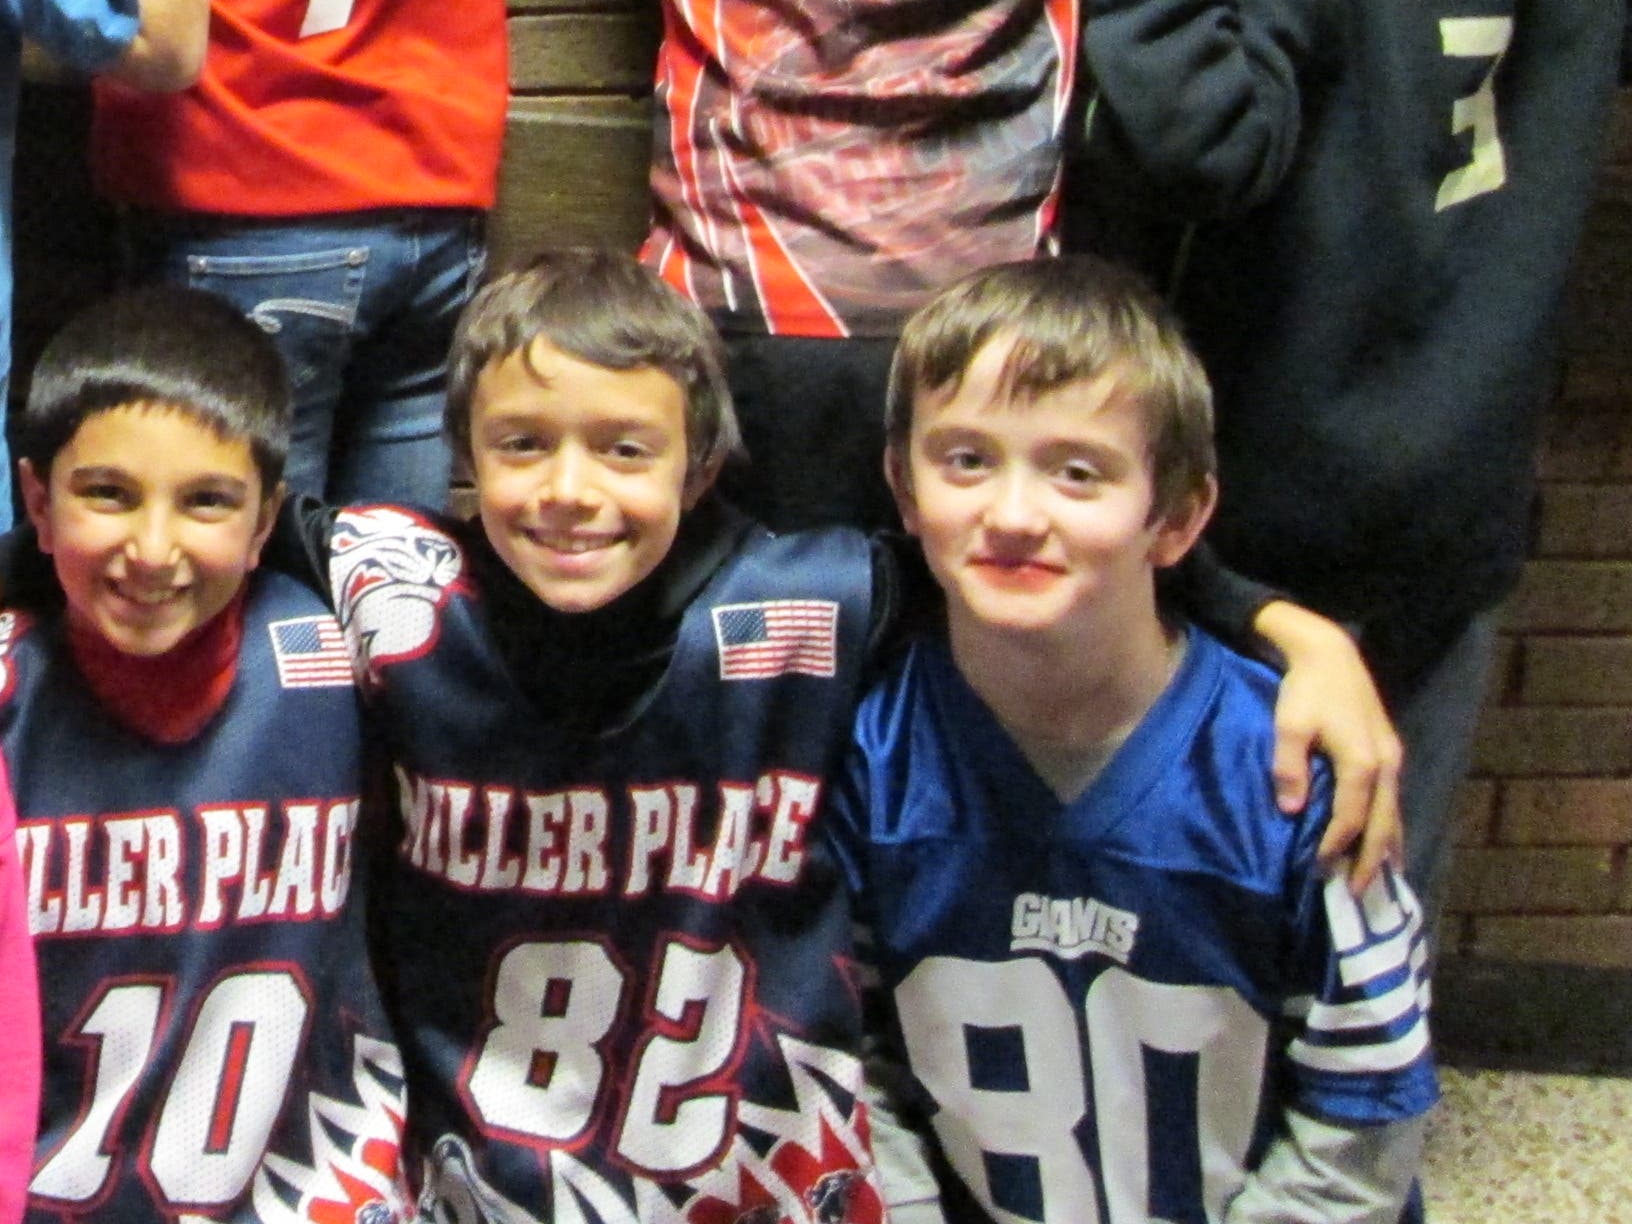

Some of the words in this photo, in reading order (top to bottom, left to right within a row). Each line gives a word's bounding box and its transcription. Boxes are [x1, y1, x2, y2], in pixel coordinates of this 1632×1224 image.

[1010, 891, 1140, 962] GIANTS
[23, 963, 313, 1214] 10
[464, 934, 752, 1176] 82
[894, 955, 1269, 1224] 80
